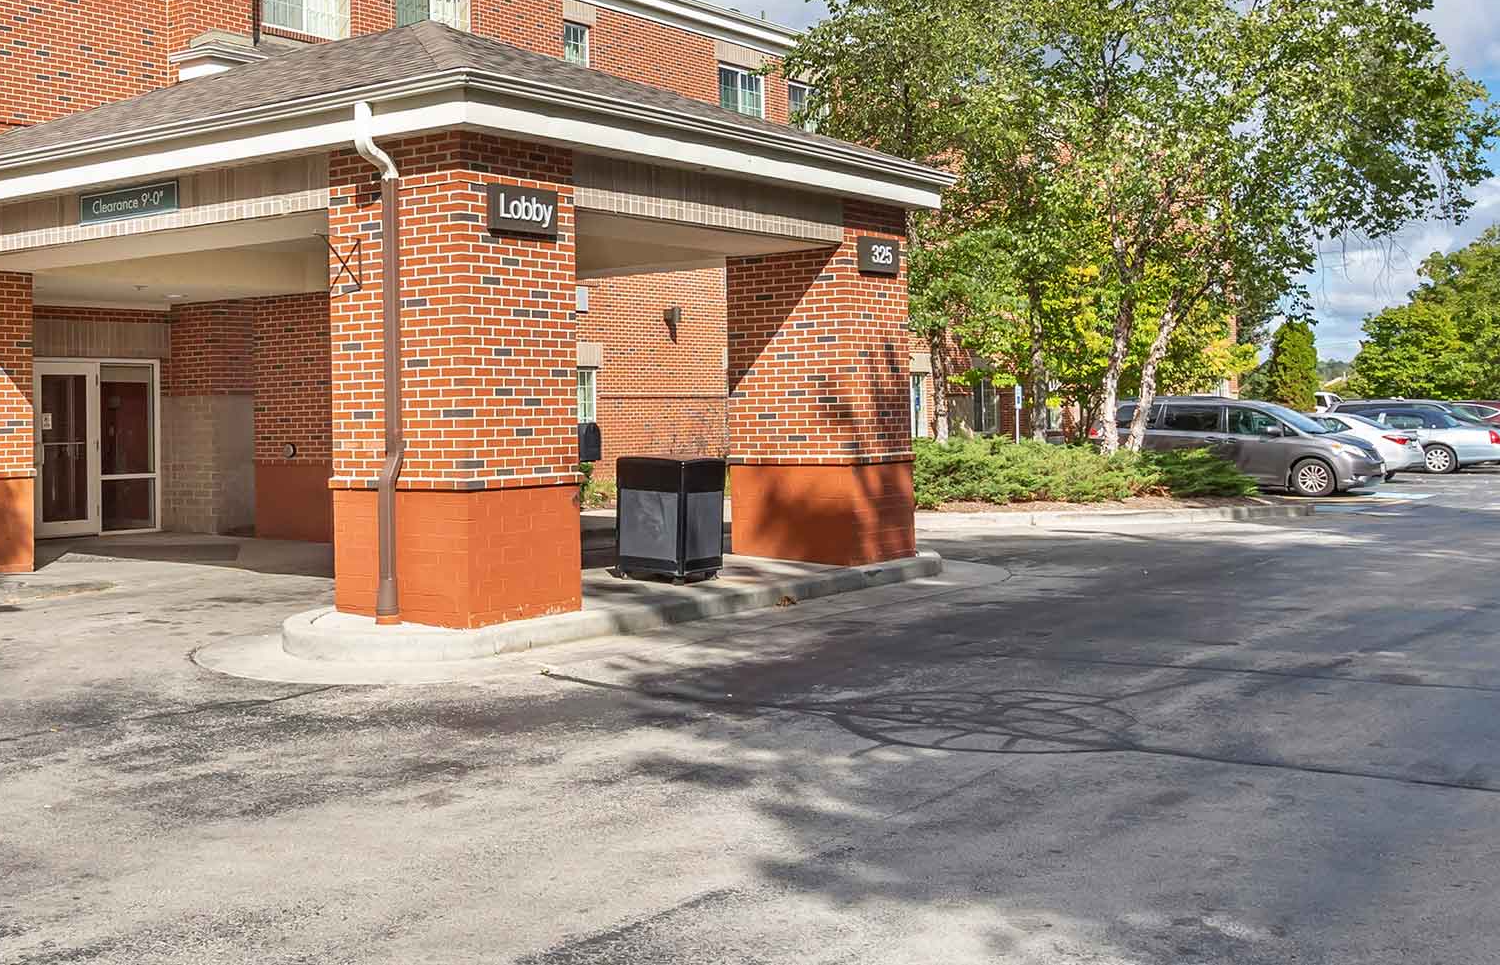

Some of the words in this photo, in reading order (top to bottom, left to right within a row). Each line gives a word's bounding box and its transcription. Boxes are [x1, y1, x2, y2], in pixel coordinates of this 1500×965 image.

[92, 197, 139, 215] Clearance
[499, 192, 553, 228] Lobby
[871, 244, 893, 265] 325
